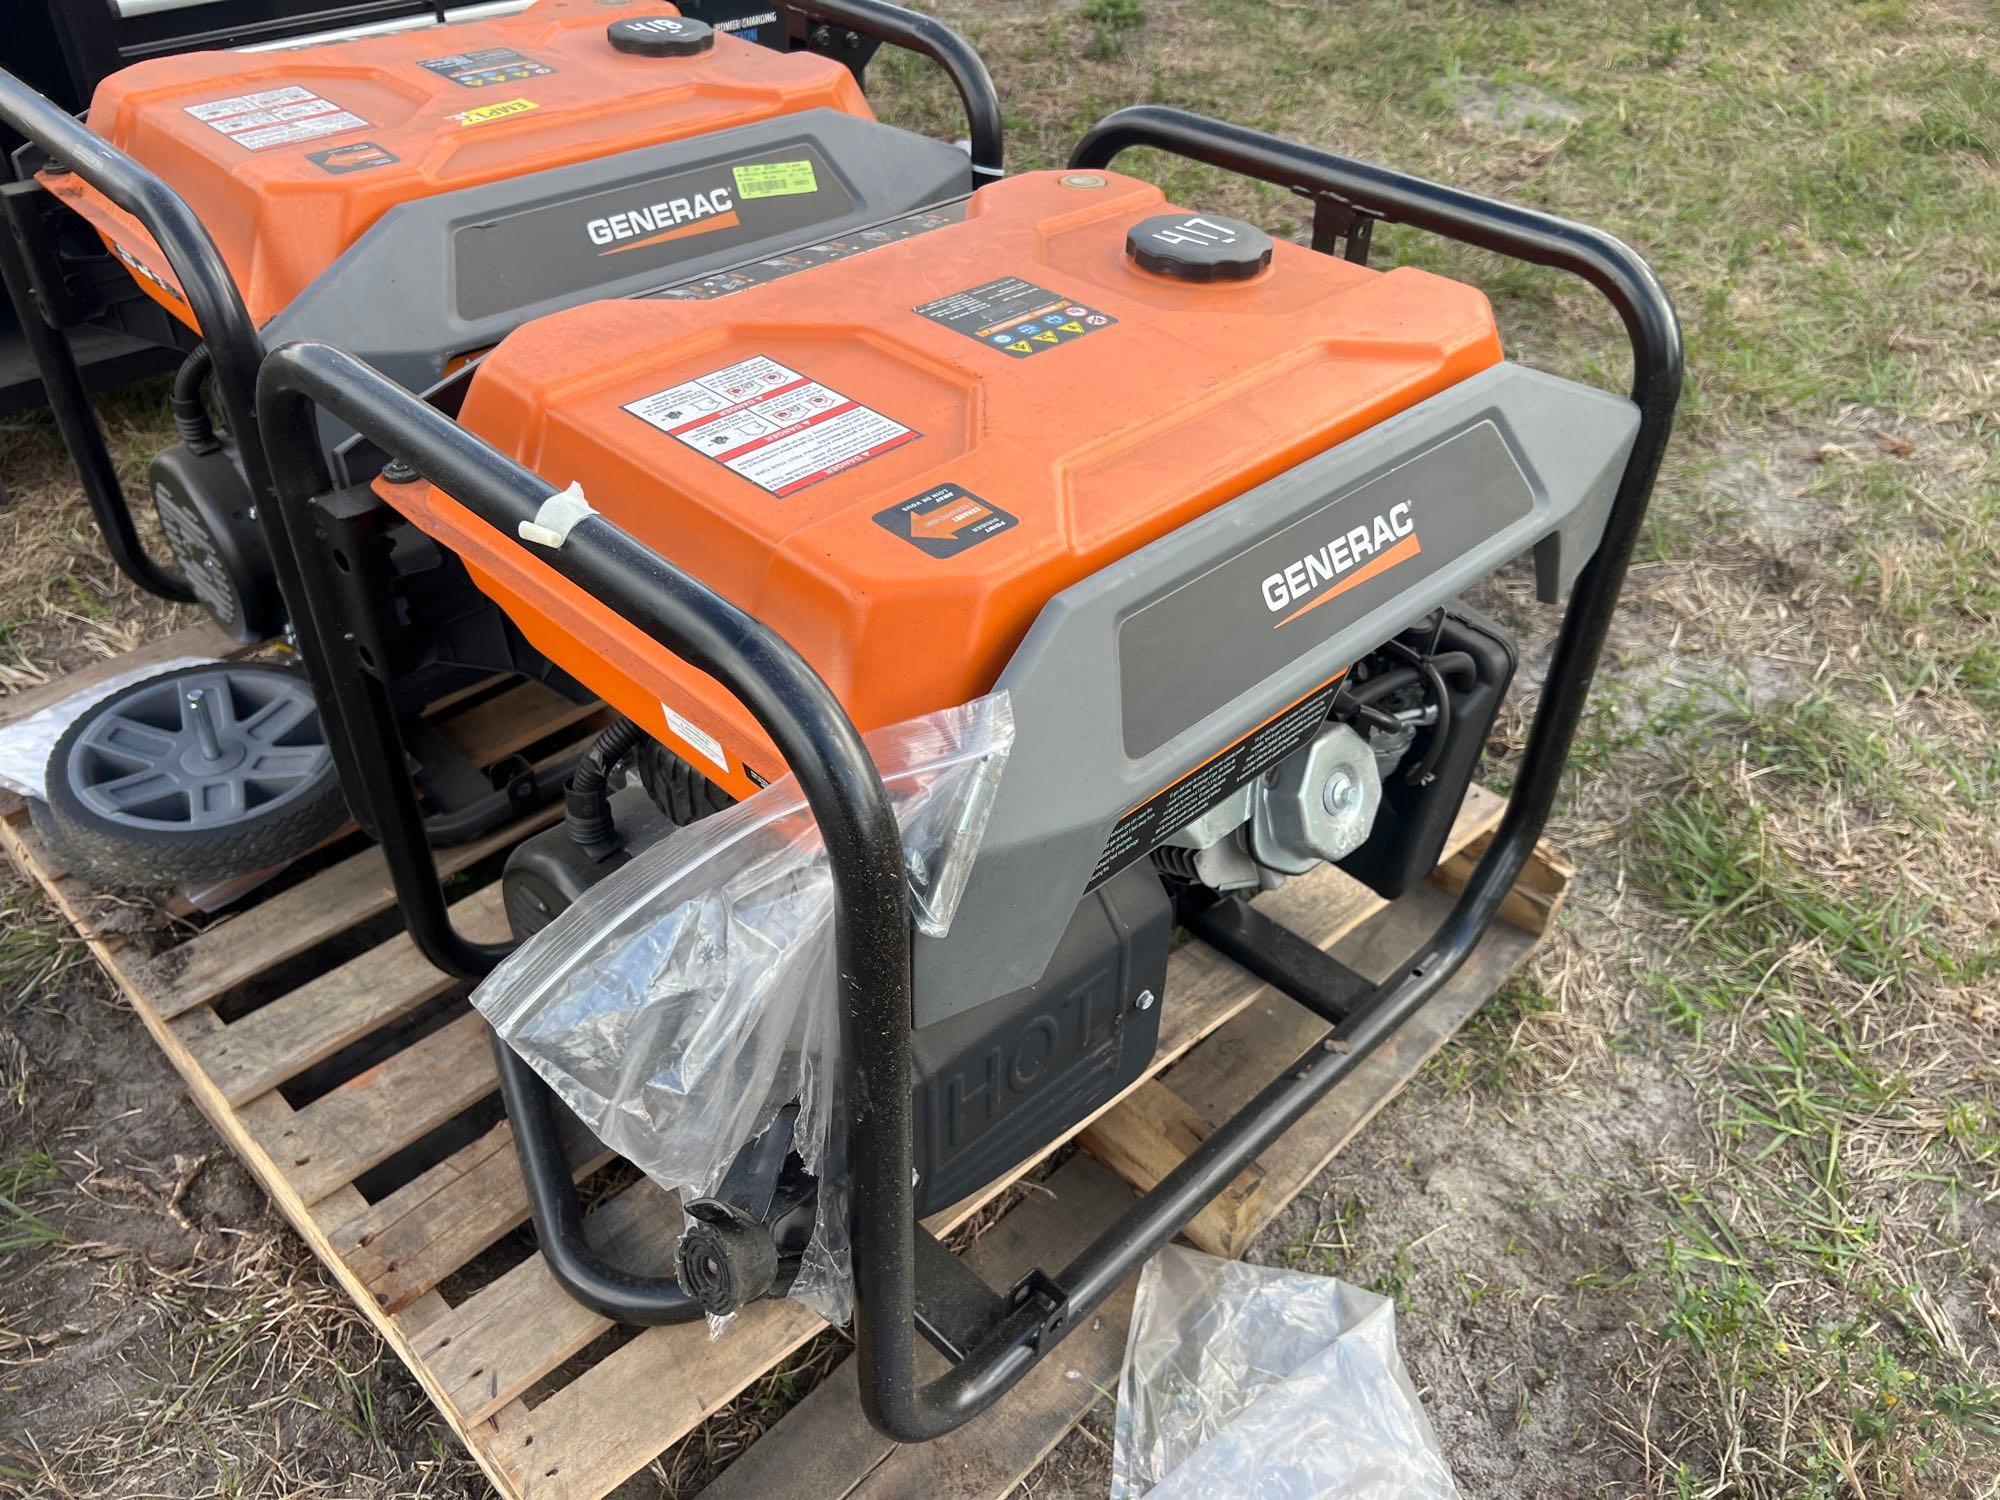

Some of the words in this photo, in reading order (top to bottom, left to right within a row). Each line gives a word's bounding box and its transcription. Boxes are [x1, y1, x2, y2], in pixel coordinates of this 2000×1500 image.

[626, 19, 683, 34] 418
[586, 187, 733, 245] GENERAC
[1152, 218, 1236, 246] 417
[1261, 502, 1413, 612] GENERAC
